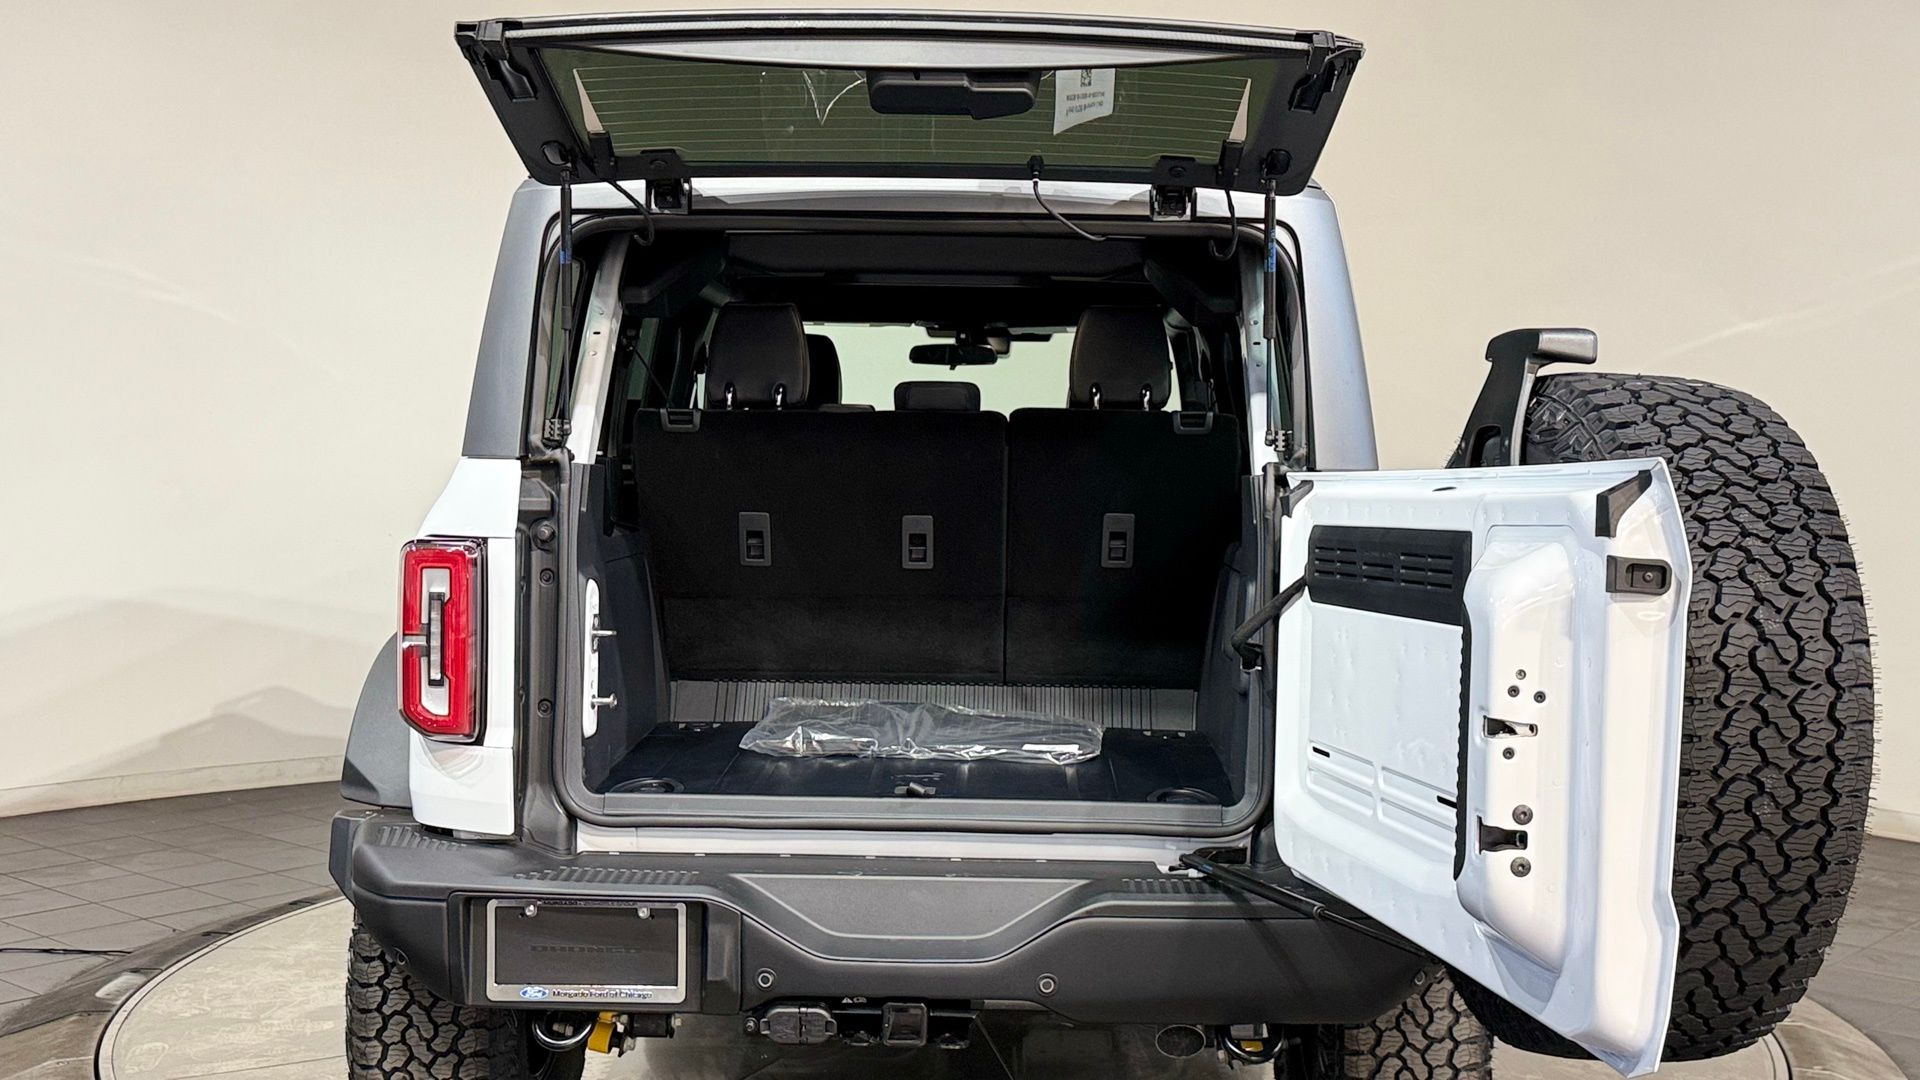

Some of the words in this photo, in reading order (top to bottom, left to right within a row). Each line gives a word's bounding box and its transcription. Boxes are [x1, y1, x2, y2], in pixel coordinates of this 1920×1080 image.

[553, 989, 588, 999] Morgado
[589, 989, 608, 998] Ford
[609, 989, 618, 998] of
[619, 989, 653, 1000] Chicago
